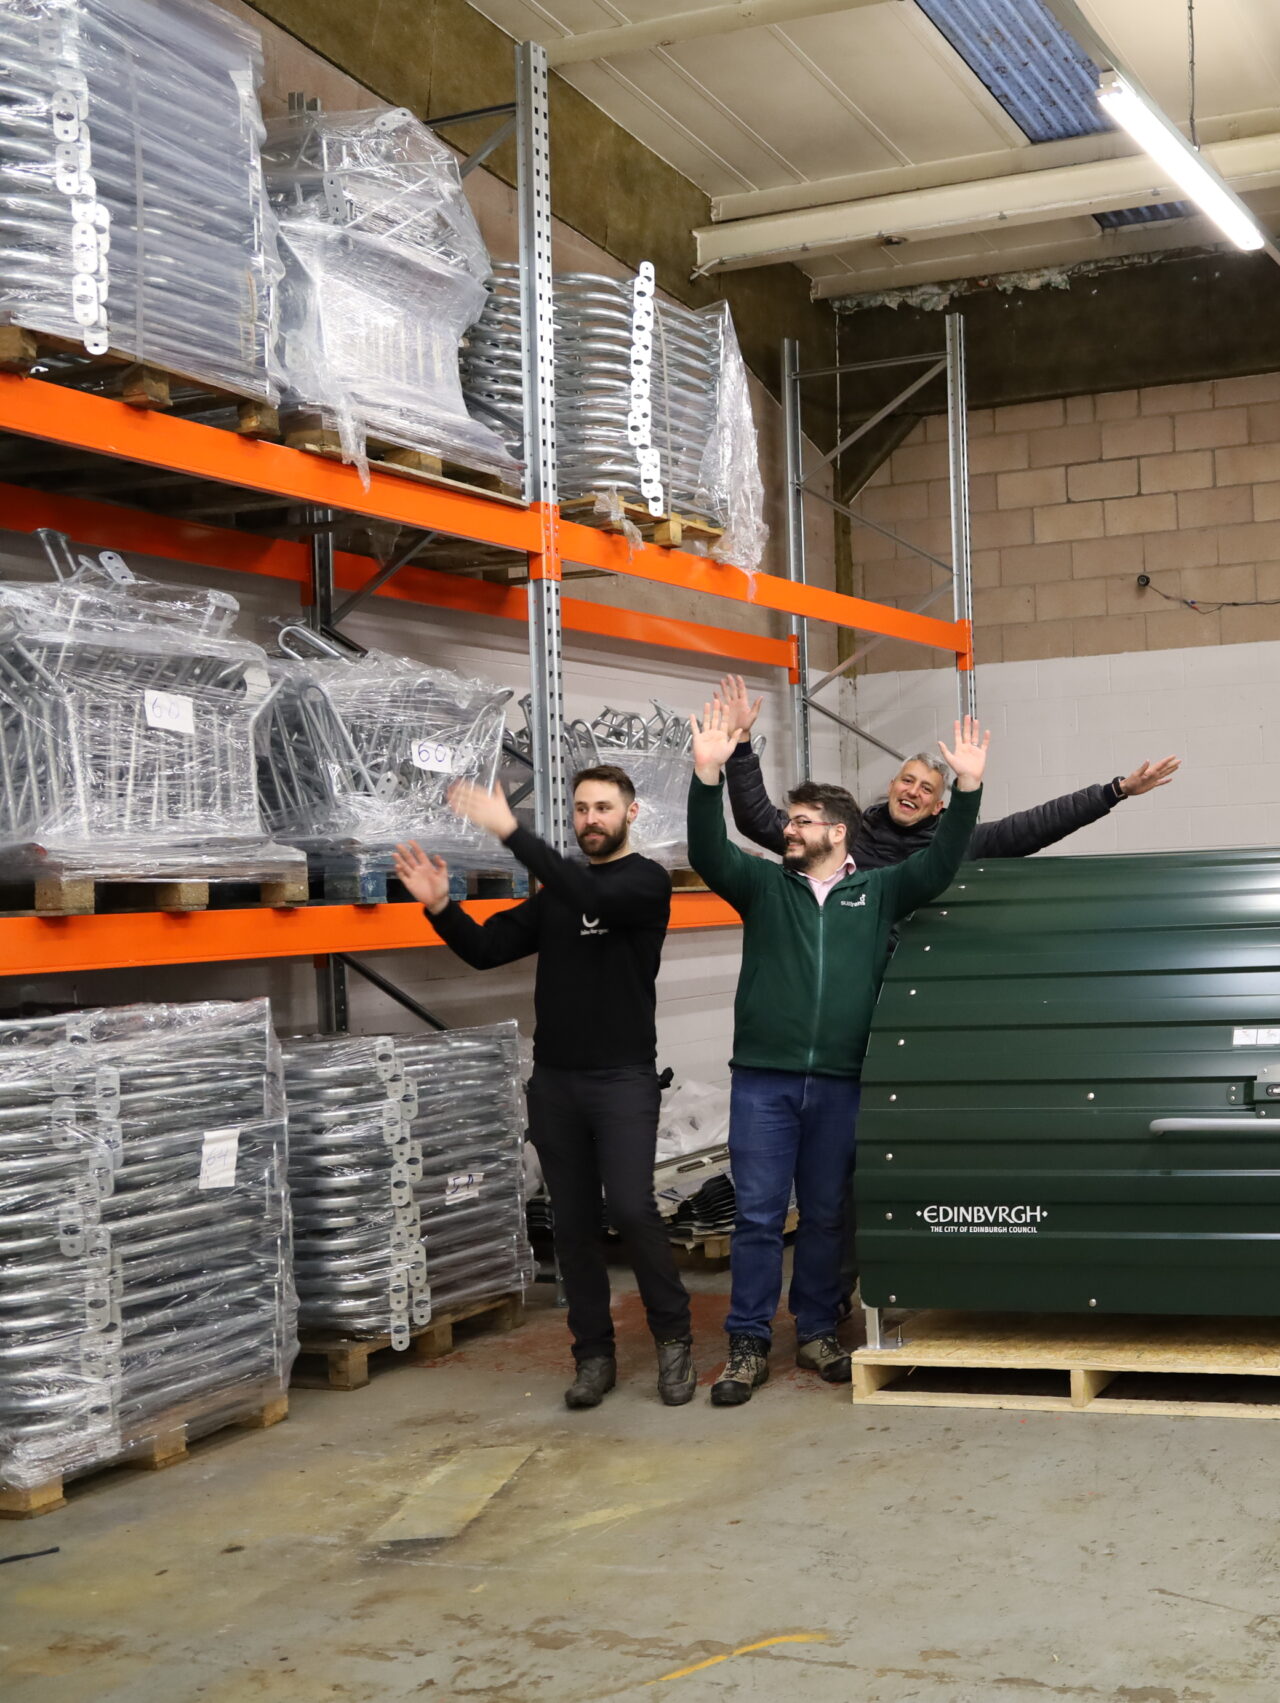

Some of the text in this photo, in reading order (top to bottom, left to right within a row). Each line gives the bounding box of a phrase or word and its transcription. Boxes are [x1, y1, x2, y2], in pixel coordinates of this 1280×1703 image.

[418, 740, 447, 763] 60
[923, 1205, 1041, 1224] EDINBVRGH
[930, 1225, 943, 1233] THE
[944, 1225, 959, 1233] CITY
[1009, 1226, 1038, 1234] COUNCIL
